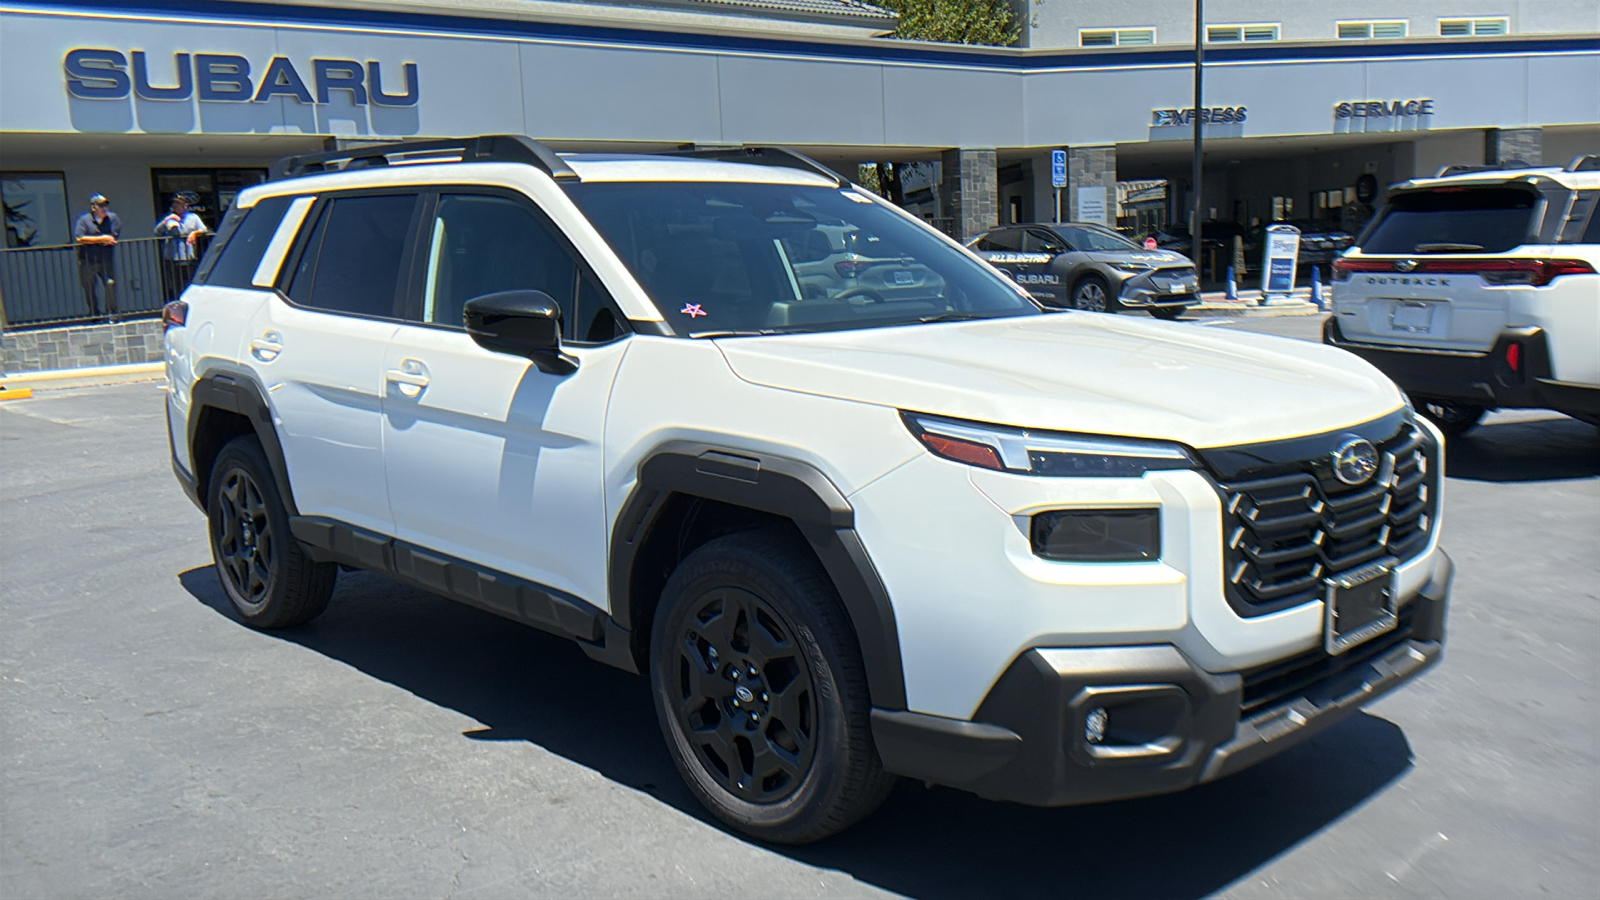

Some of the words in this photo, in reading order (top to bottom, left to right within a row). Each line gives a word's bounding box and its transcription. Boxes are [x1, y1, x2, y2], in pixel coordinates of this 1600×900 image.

[64, 48, 419, 107] SUBARU
[1336, 100, 1434, 119] SERVICE
[989, 253, 1006, 263] ALL
[1007, 253, 1051, 263] ELECTRIC
[1016, 275, 1059, 284] SUBARU
[1366, 276, 1451, 287] OUTBACK
